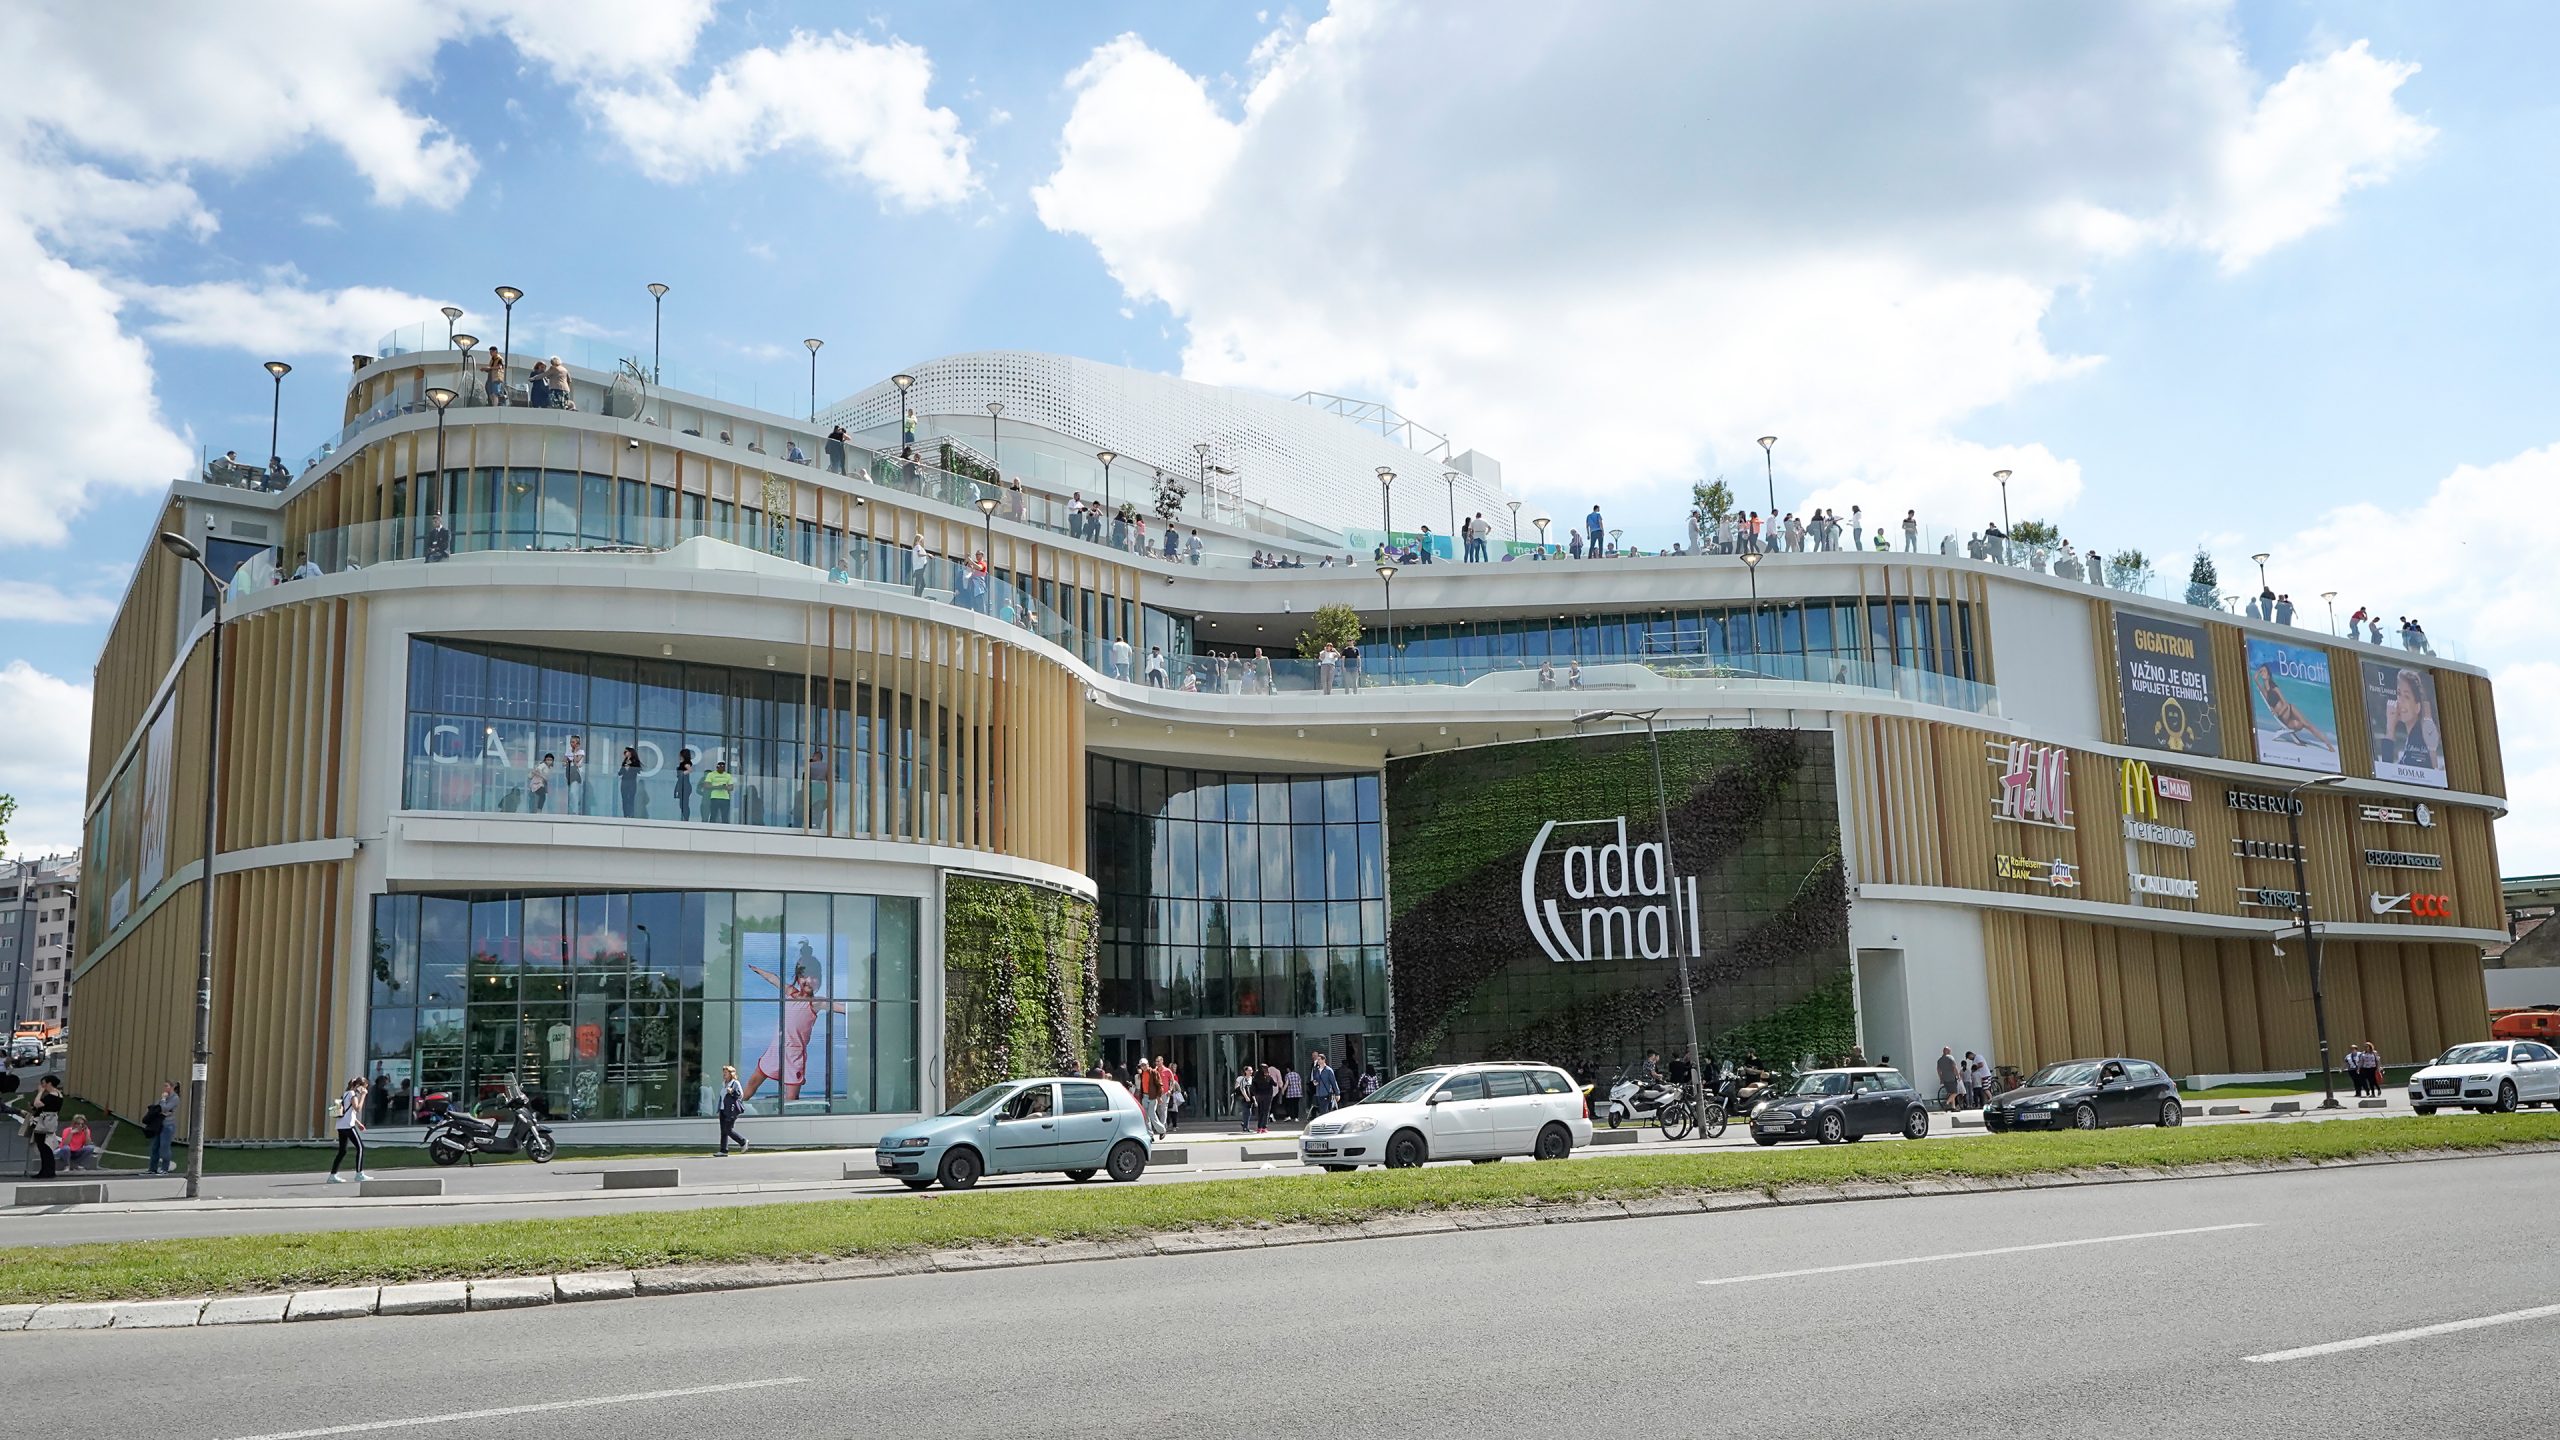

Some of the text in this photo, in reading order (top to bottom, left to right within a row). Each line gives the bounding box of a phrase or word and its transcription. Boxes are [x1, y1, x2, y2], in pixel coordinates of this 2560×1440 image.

[2134, 629, 2195, 660] GIGATRON
[2130, 660, 2166, 683] VAŽNO
[2168, 668, 2180, 685] JE
[2278, 650, 2329, 684] Bonatti
[2131, 679, 2171, 697] KUPUJETE
[423, 725, 740, 779] CALIOPE
[1999, 740, 2066, 827] H&M
[2397, 767, 2426, 779] BOMAR
[2169, 781, 2190, 799] MAXI
[2129, 820, 2197, 848] Terranova
[1563, 815, 1666, 900] ada
[2054, 858, 2070, 876] dm
[2366, 850, 2404, 867] CROPP
[2011, 867, 2032, 881] BANK
[2136, 873, 2199, 899] CALLIOPE
[2410, 892, 2451, 917] CCC
